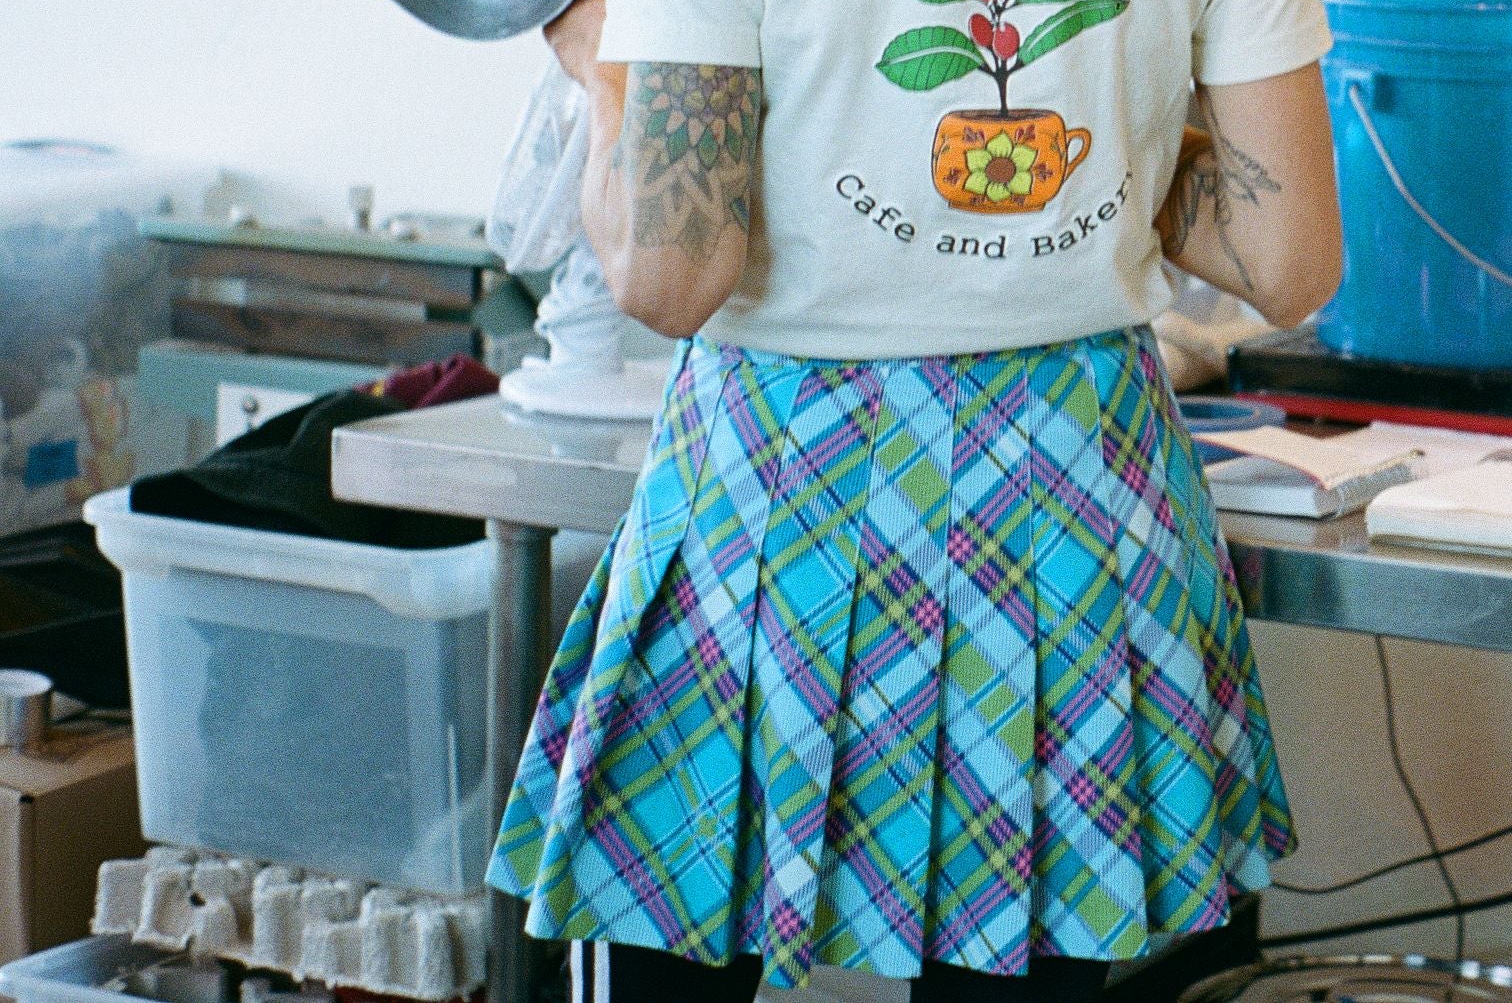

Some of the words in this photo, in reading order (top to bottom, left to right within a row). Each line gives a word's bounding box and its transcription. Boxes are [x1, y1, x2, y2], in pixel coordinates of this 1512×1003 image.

[835, 173, 916, 244] Cafe
[936, 234, 1006, 259] and
[1031, 161, 1133, 258] Baker
